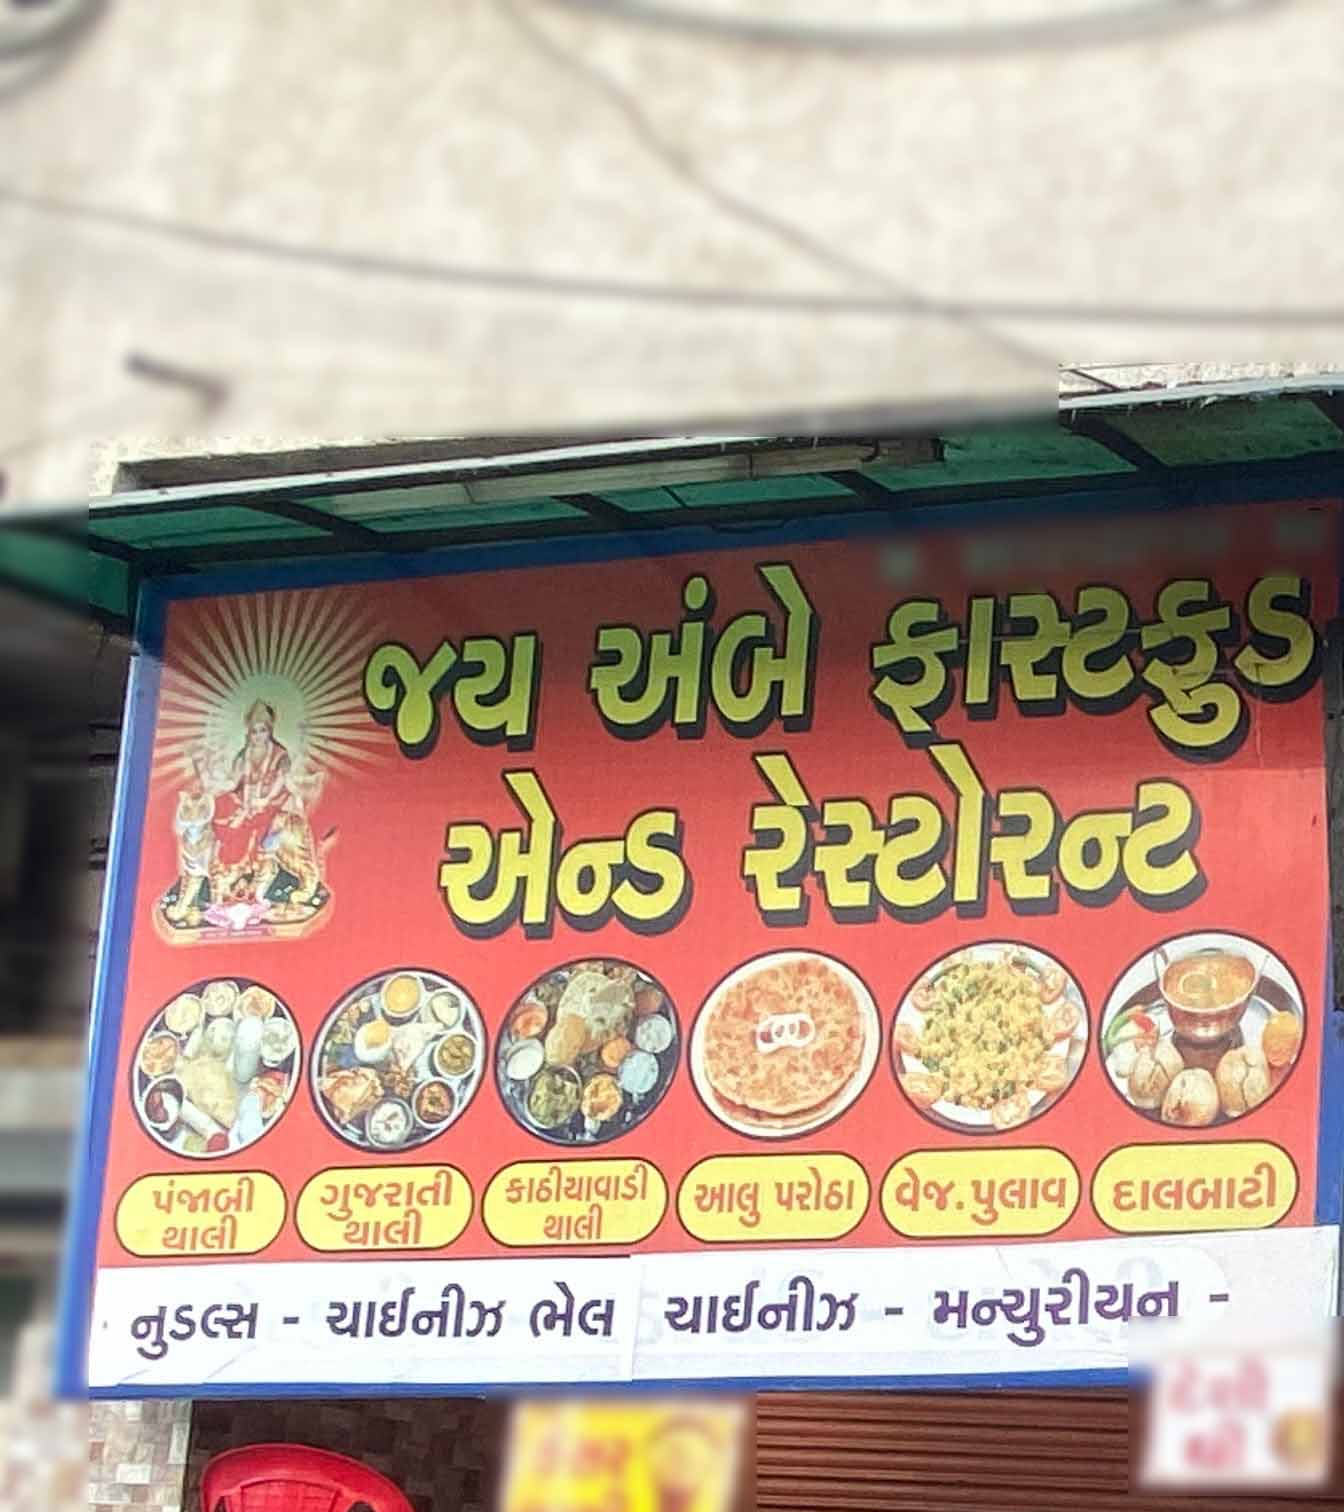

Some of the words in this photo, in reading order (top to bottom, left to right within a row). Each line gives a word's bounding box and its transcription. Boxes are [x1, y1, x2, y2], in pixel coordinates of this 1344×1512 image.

[363, 632, 541, 758] જય
[586, 562, 820, 740] અંબે
[439, 767, 693, 941] એન્ડ
[742, 742, 1207, 926] રેસ્ટોરન્ટ
[151, 1175, 255, 1215] પંજાબી
[319, 1169, 454, 1222] ગુજરાતી
[504, 1163, 649, 1205] કાઠીયાવાડી
[694, 1181, 761, 1229] આલુ
[774, 1166, 856, 1212] પરોઠા
[1112, 1160, 1278, 1212] દાલબાટી
[161, 1213, 238, 1251] થાલી
[343, 1207, 423, 1247] થાલી
[543, 1203, 604, 1241] થાલી
[130, 1302, 260, 1361] નુડલ્સ
[529, 1280, 616, 1339] ભેલ
